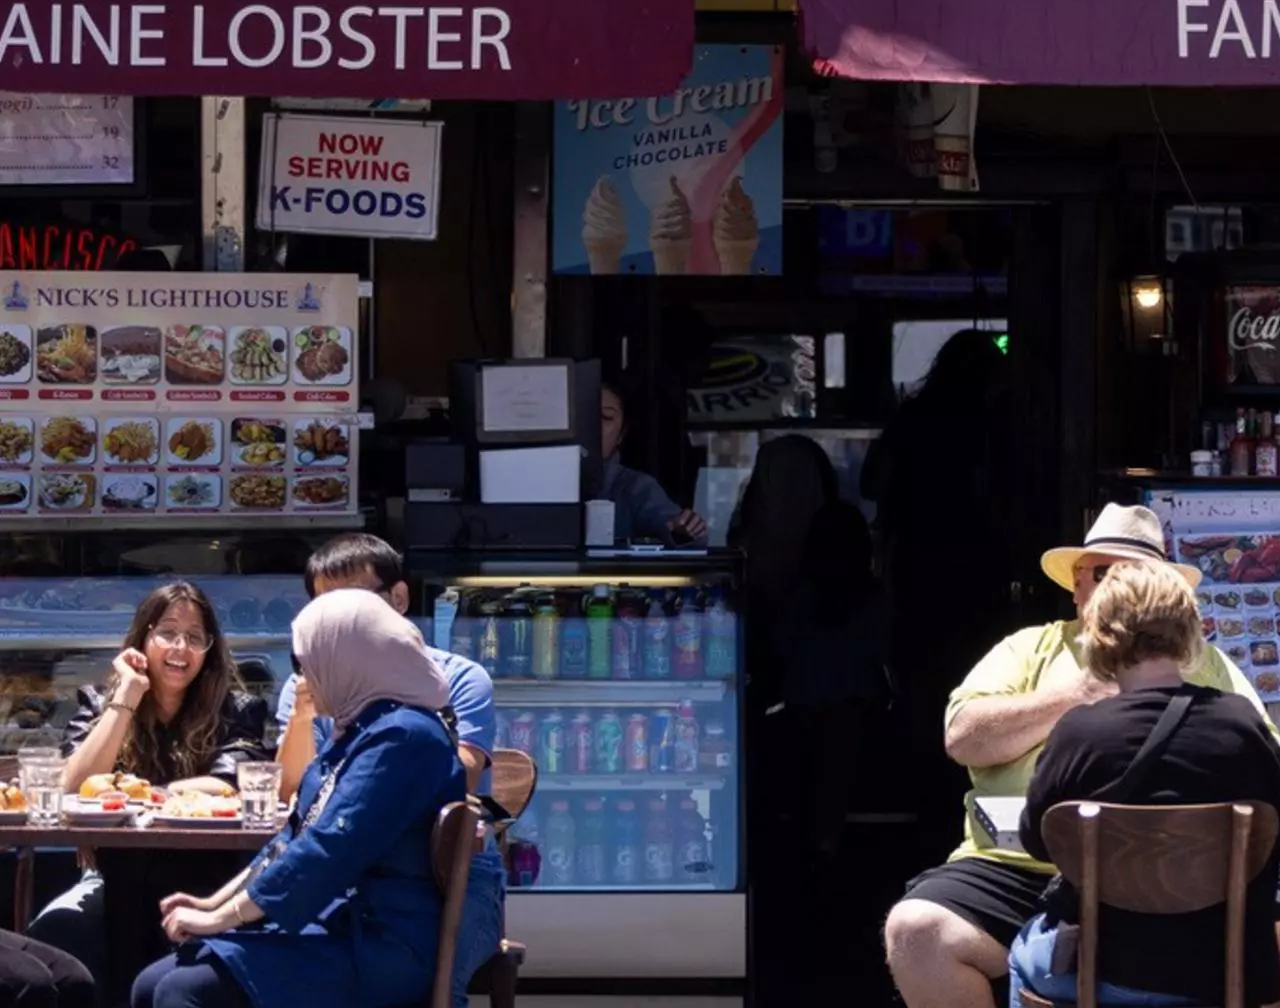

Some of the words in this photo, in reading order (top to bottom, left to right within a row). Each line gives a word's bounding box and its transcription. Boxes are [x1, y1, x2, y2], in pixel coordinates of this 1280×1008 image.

[193, 4, 511, 70] LOBSTER
[101, 96, 119, 110] 17
[646, 75, 774, 125] Cream
[318, 132, 384, 156] NOW
[632, 122, 713, 147] VANILLA
[101, 155, 119, 169] 32
[613, 139, 728, 170] CHOCOLATE
[287, 156, 411, 183] SERVING
[270, 184, 426, 219] K-FOODS
[35, 287, 119, 309] NICK'S
[126, 287, 288, 309] LIGHTHOUSE
